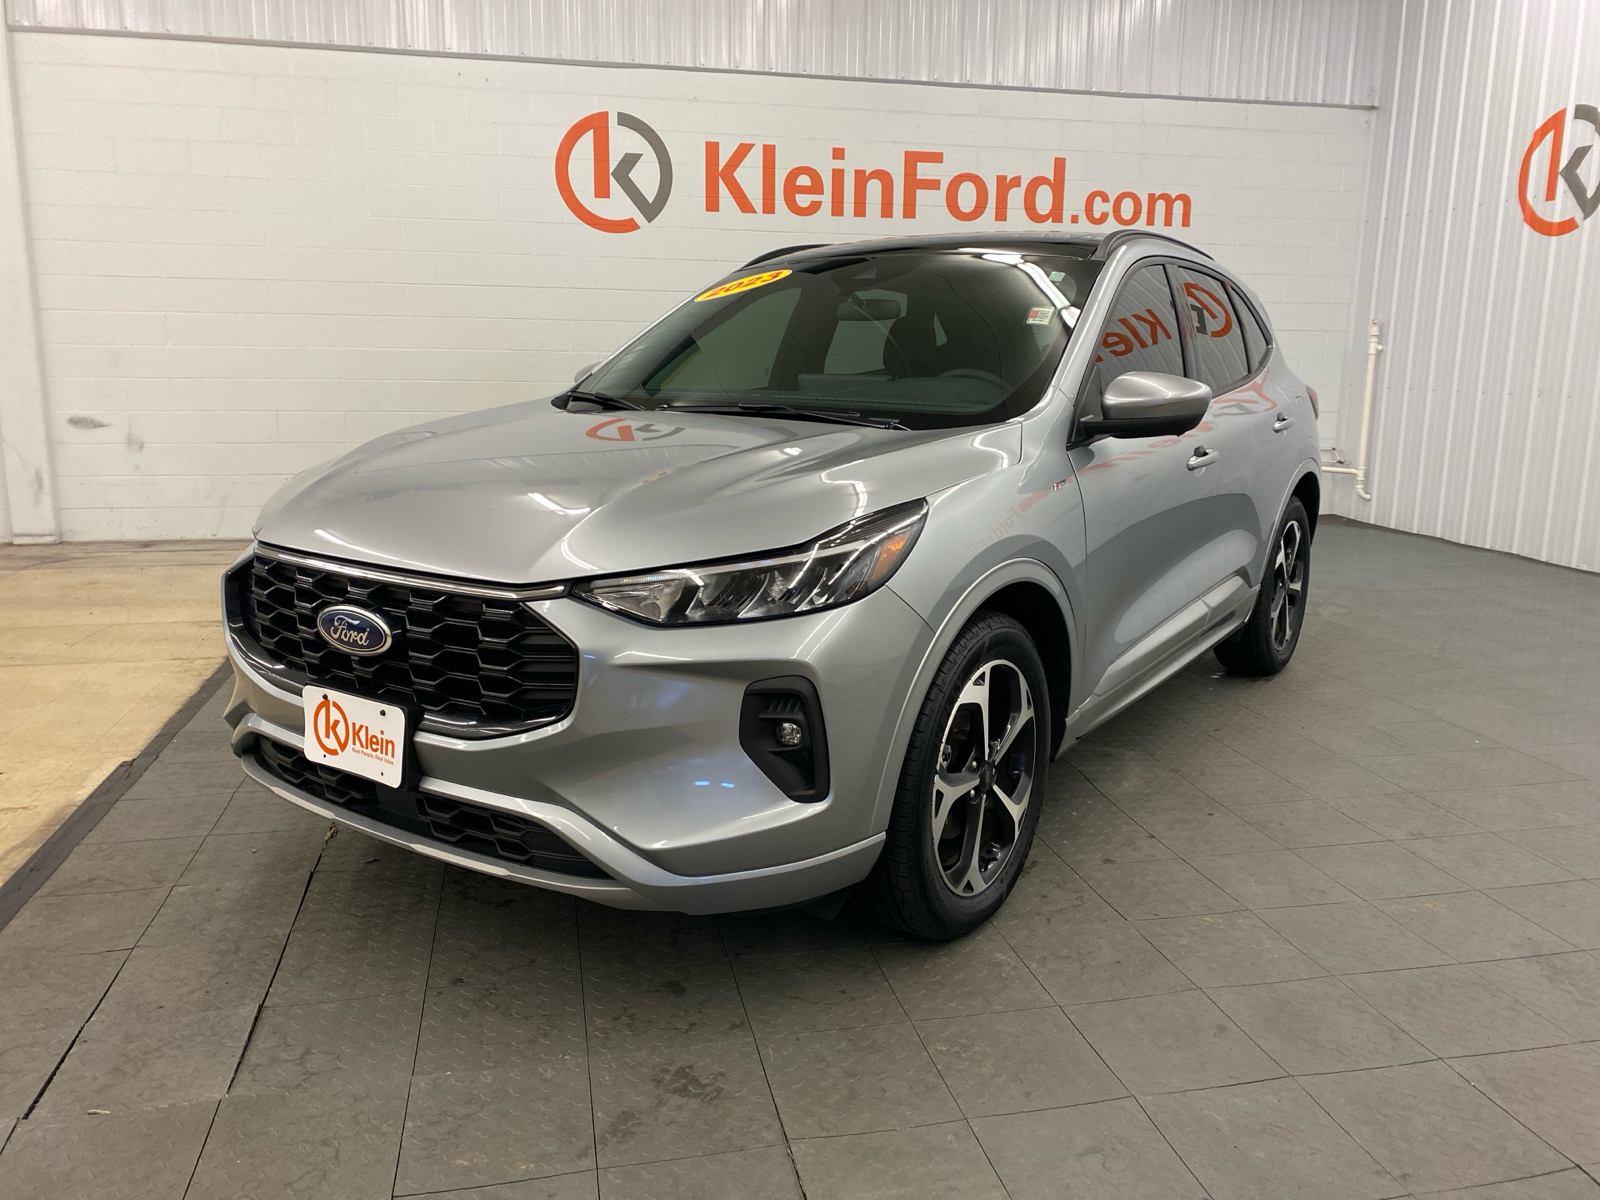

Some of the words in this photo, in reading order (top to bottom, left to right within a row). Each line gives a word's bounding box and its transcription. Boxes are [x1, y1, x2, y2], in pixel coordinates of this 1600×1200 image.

[705, 140, 1192, 228] KleinFord.com
[703, 270, 783, 299] 2023
[330, 614, 370, 646] Ford
[351, 721, 395, 759] Klein
